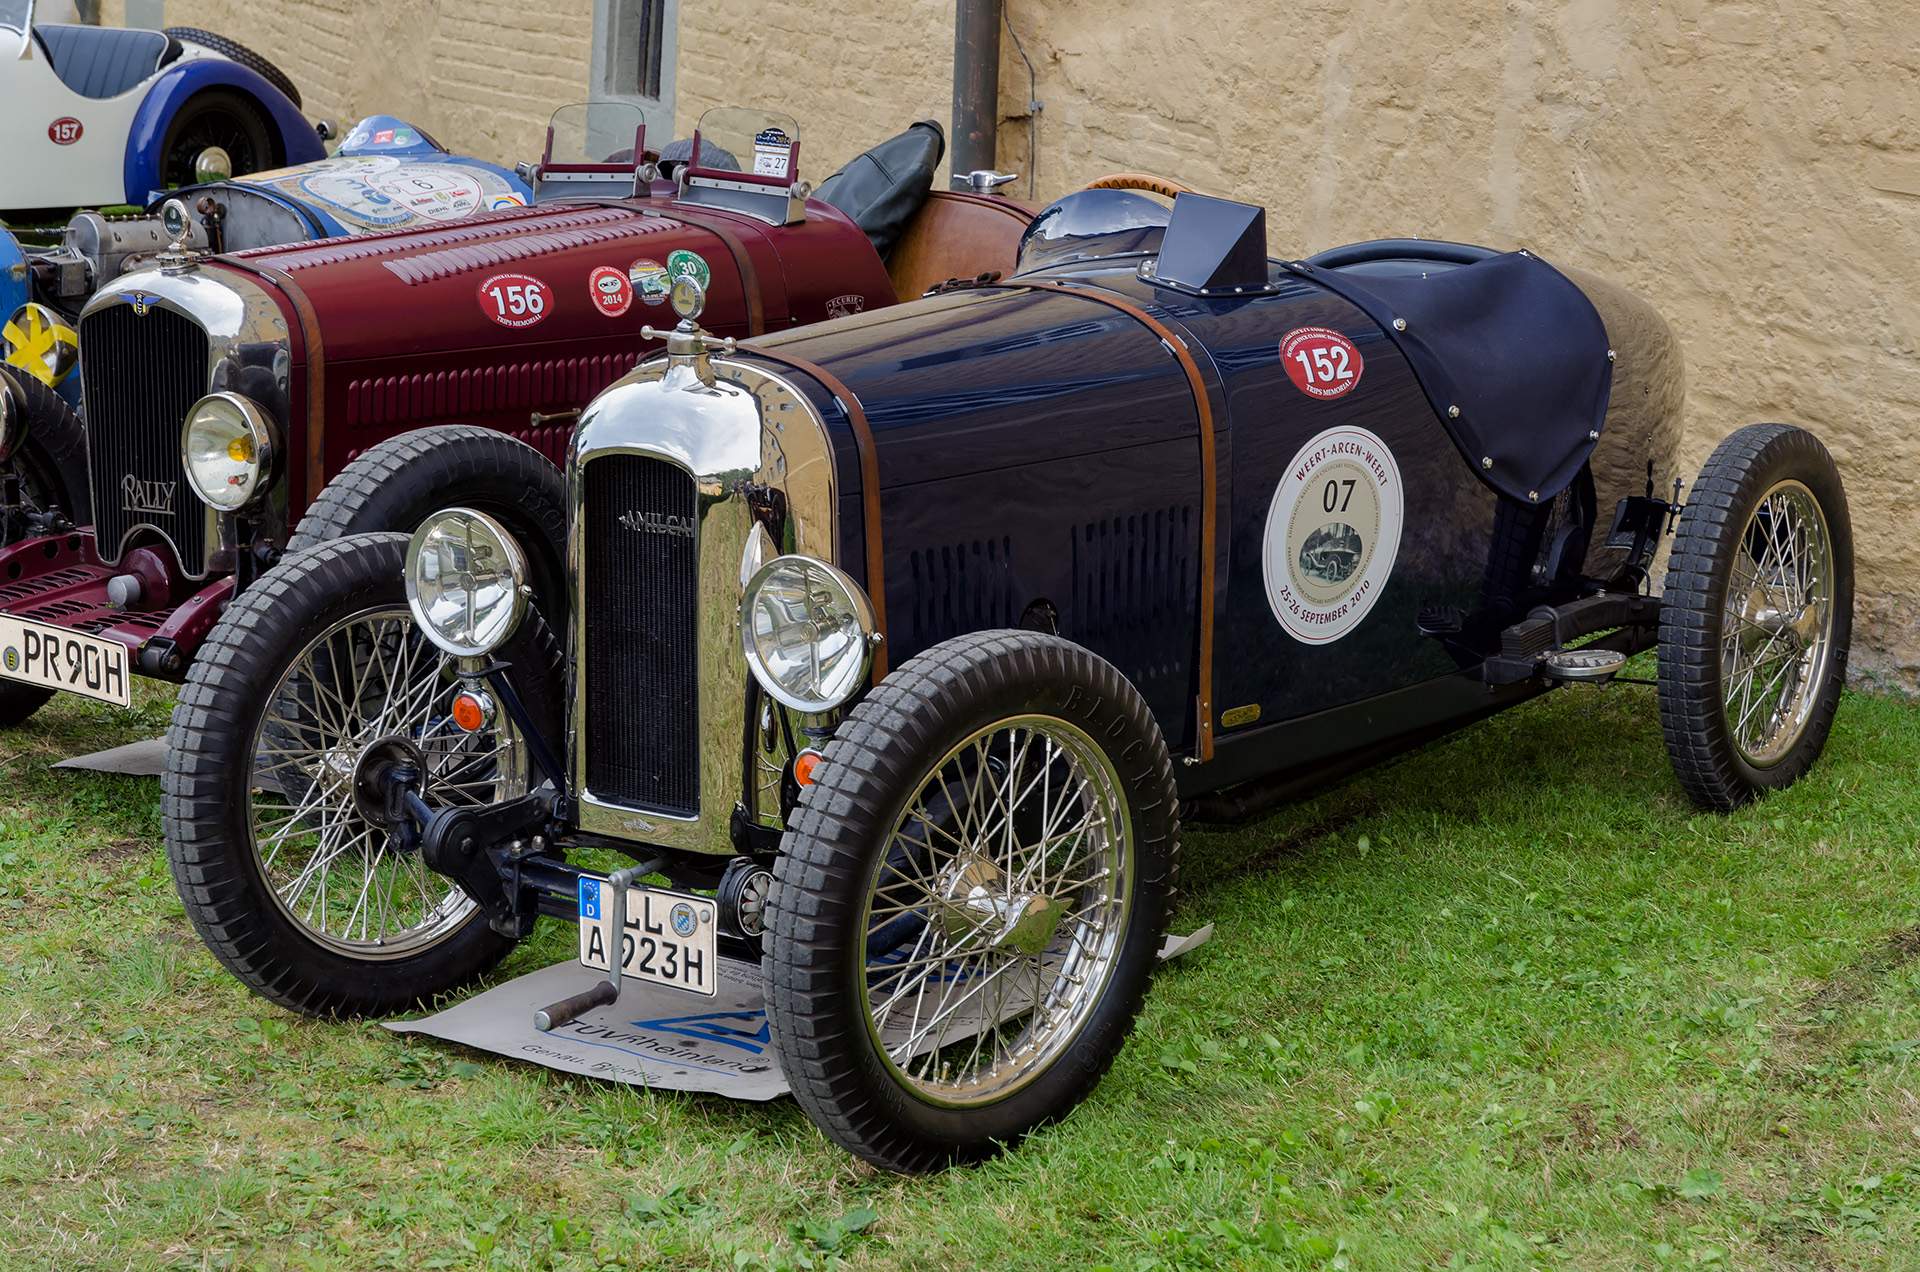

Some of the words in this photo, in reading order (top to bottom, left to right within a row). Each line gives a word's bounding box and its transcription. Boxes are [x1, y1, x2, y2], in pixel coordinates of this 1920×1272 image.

[54, 124, 79, 139] 157
[774, 157, 787, 169] 27
[679, 261, 697, 275] 30
[489, 284, 544, 315] 156
[602, 294, 623, 305] 2014
[512, 314, 542, 327] MEMORIAL
[1295, 346, 1353, 383] 152
[1322, 379, 1352, 396] MEMORIAL
[1296, 442, 1387, 487] WEERT-ARCEN-WEERT
[121, 473, 176, 514] RALLY
[1323, 480, 1356, 513] 07
[1280, 585, 1301, 615] 25-26
[1300, 604, 1348, 624] SEPTEMBER
[1350, 580, 1370, 608] 2010
[586, 904, 595, 916] D
